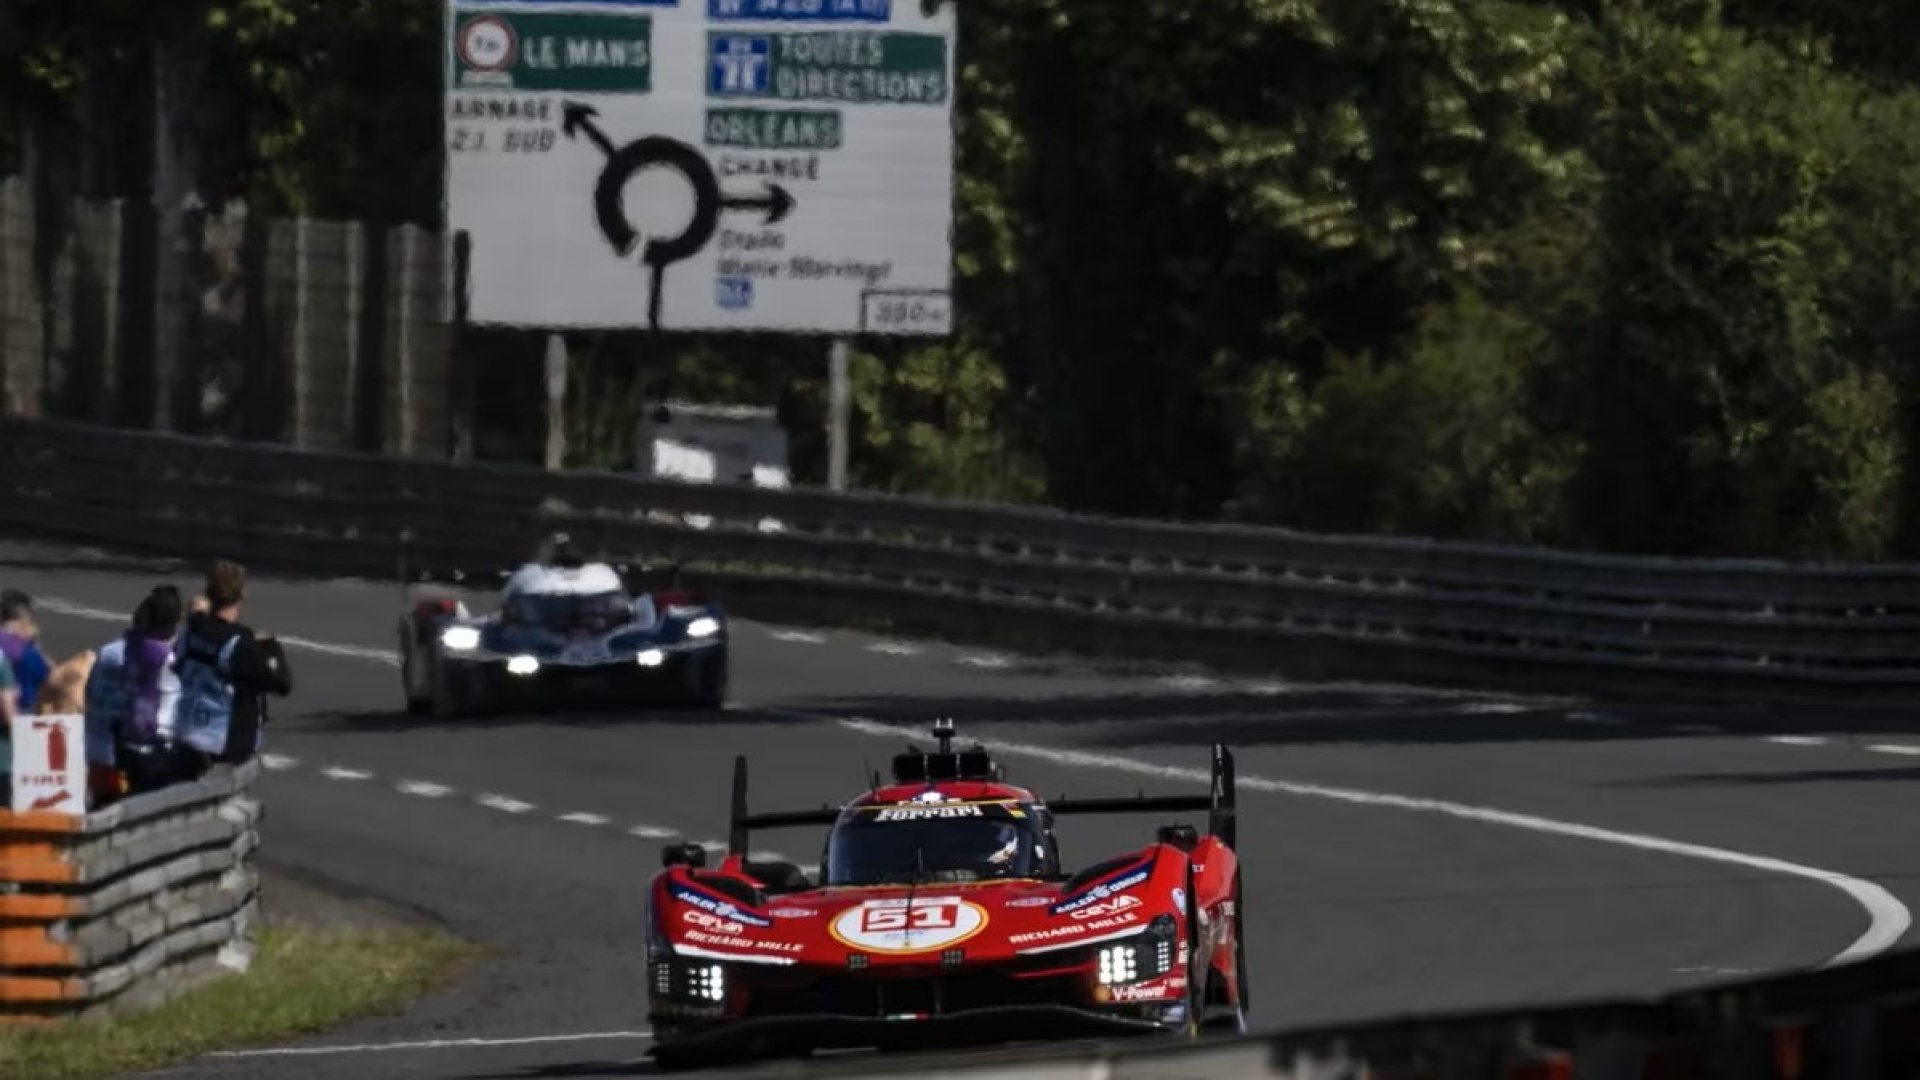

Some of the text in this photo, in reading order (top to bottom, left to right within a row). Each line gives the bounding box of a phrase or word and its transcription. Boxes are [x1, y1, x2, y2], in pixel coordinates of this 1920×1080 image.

[522, 36, 557, 68] LE
[566, 38, 648, 68] MANS
[781, 33, 884, 66] TOUTES
[776, 67, 944, 101] DIRECTIONS
[452, 97, 552, 119] ARNAGE
[873, 804, 983, 822] Ferrari
[866, 907, 951, 930] 51
[1008, 912, 1138, 944] RICHARD MILLE
[684, 929, 754, 948] RICHARD
[755, 940, 805, 953] MILLE
[1111, 984, 1167, 1001] V-Power
